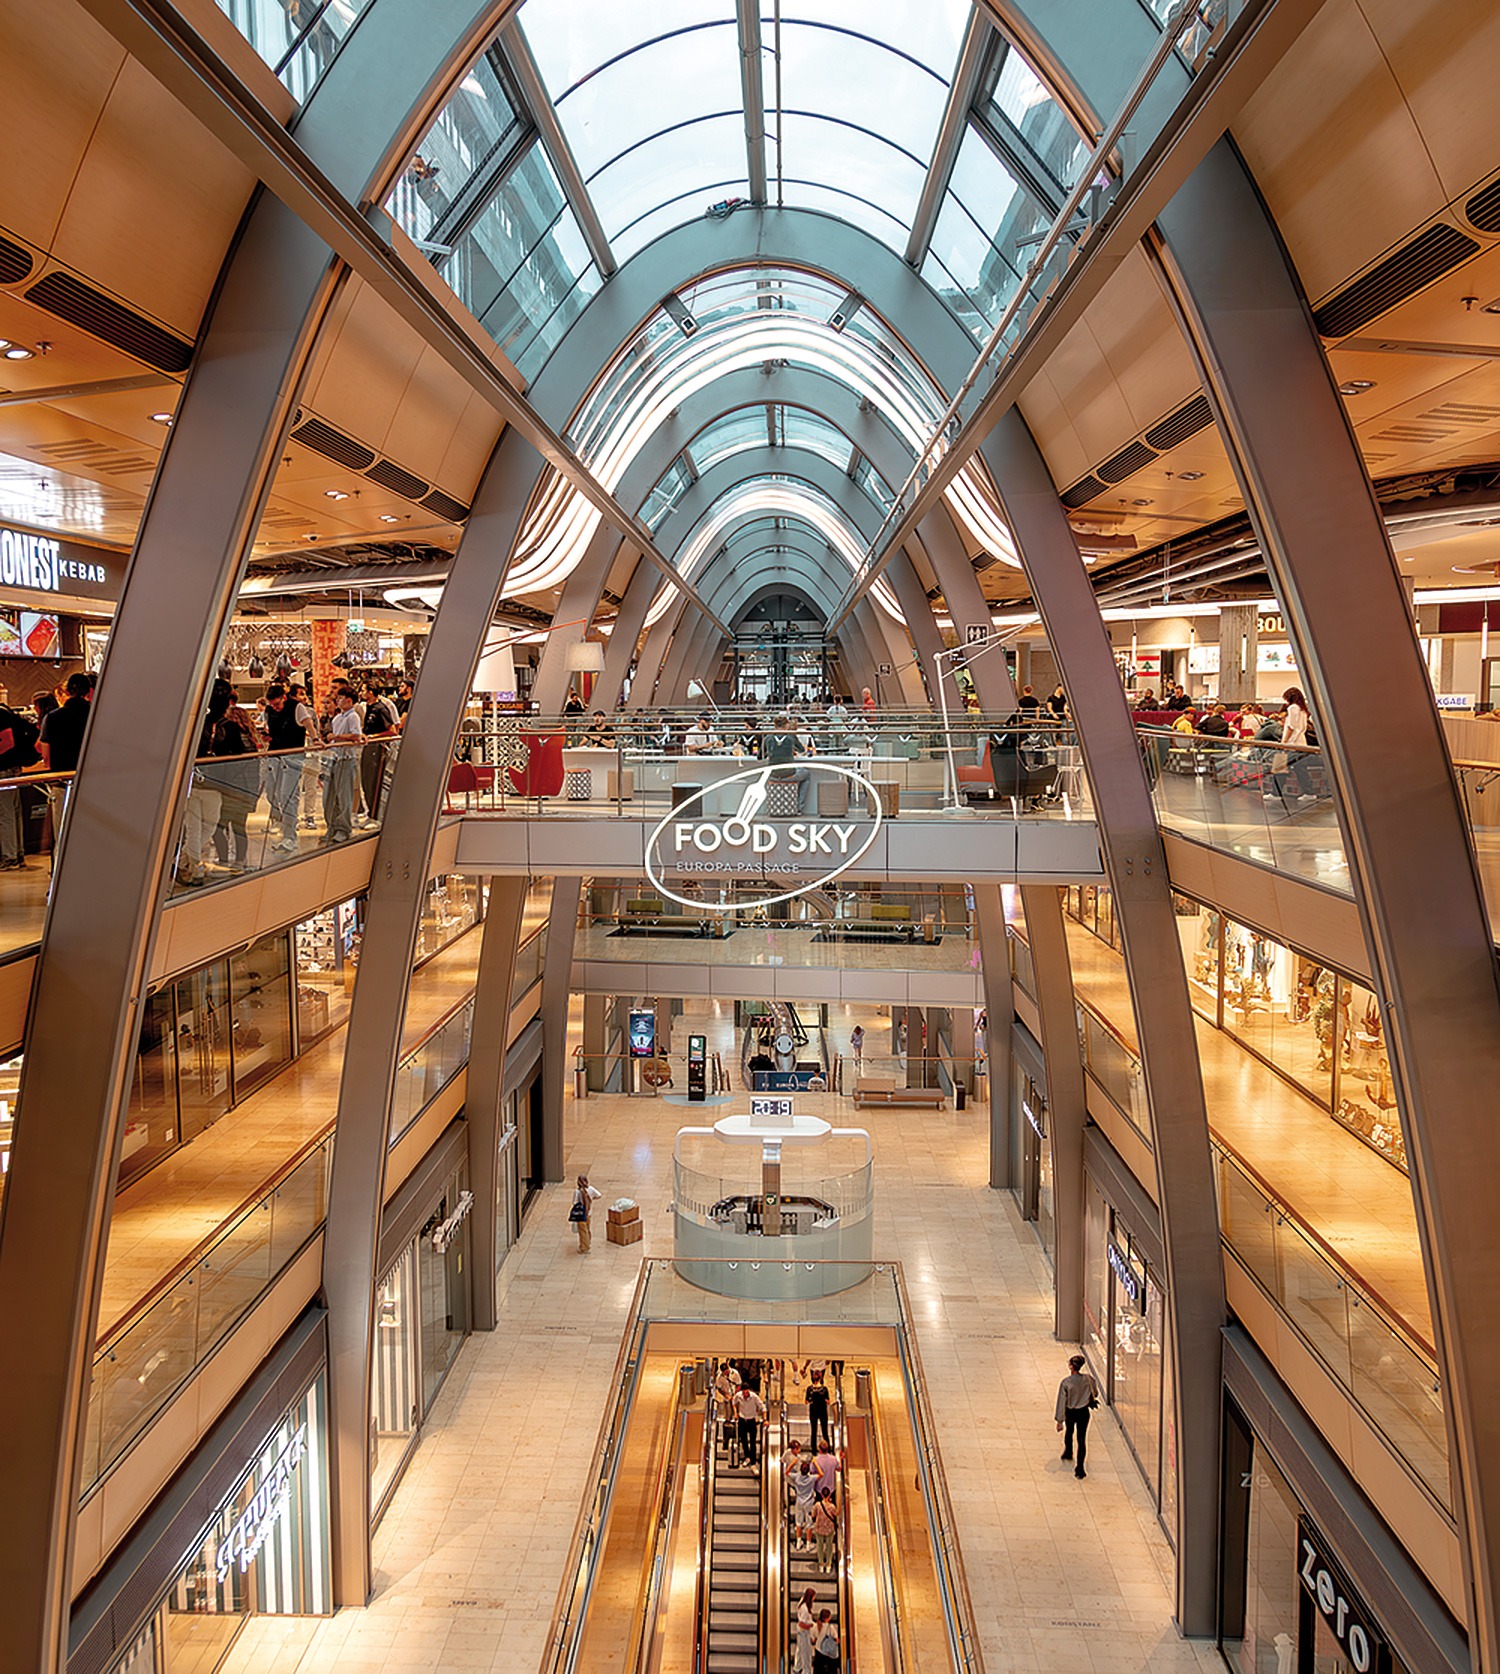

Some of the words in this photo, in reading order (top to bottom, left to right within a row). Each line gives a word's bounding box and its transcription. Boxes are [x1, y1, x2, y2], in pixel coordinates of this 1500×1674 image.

[0, 529, 59, 591] ONEST
[59, 559, 105, 583] KEBAB
[675, 816, 778, 852] FOOD
[788, 824, 857, 853] SKY
[676, 862, 733, 873] EUROPA
[737, 863, 799, 874] PASSAGE
[754, 1101, 790, 1115] 20:19
[1301, 1539, 1370, 1673] zero
